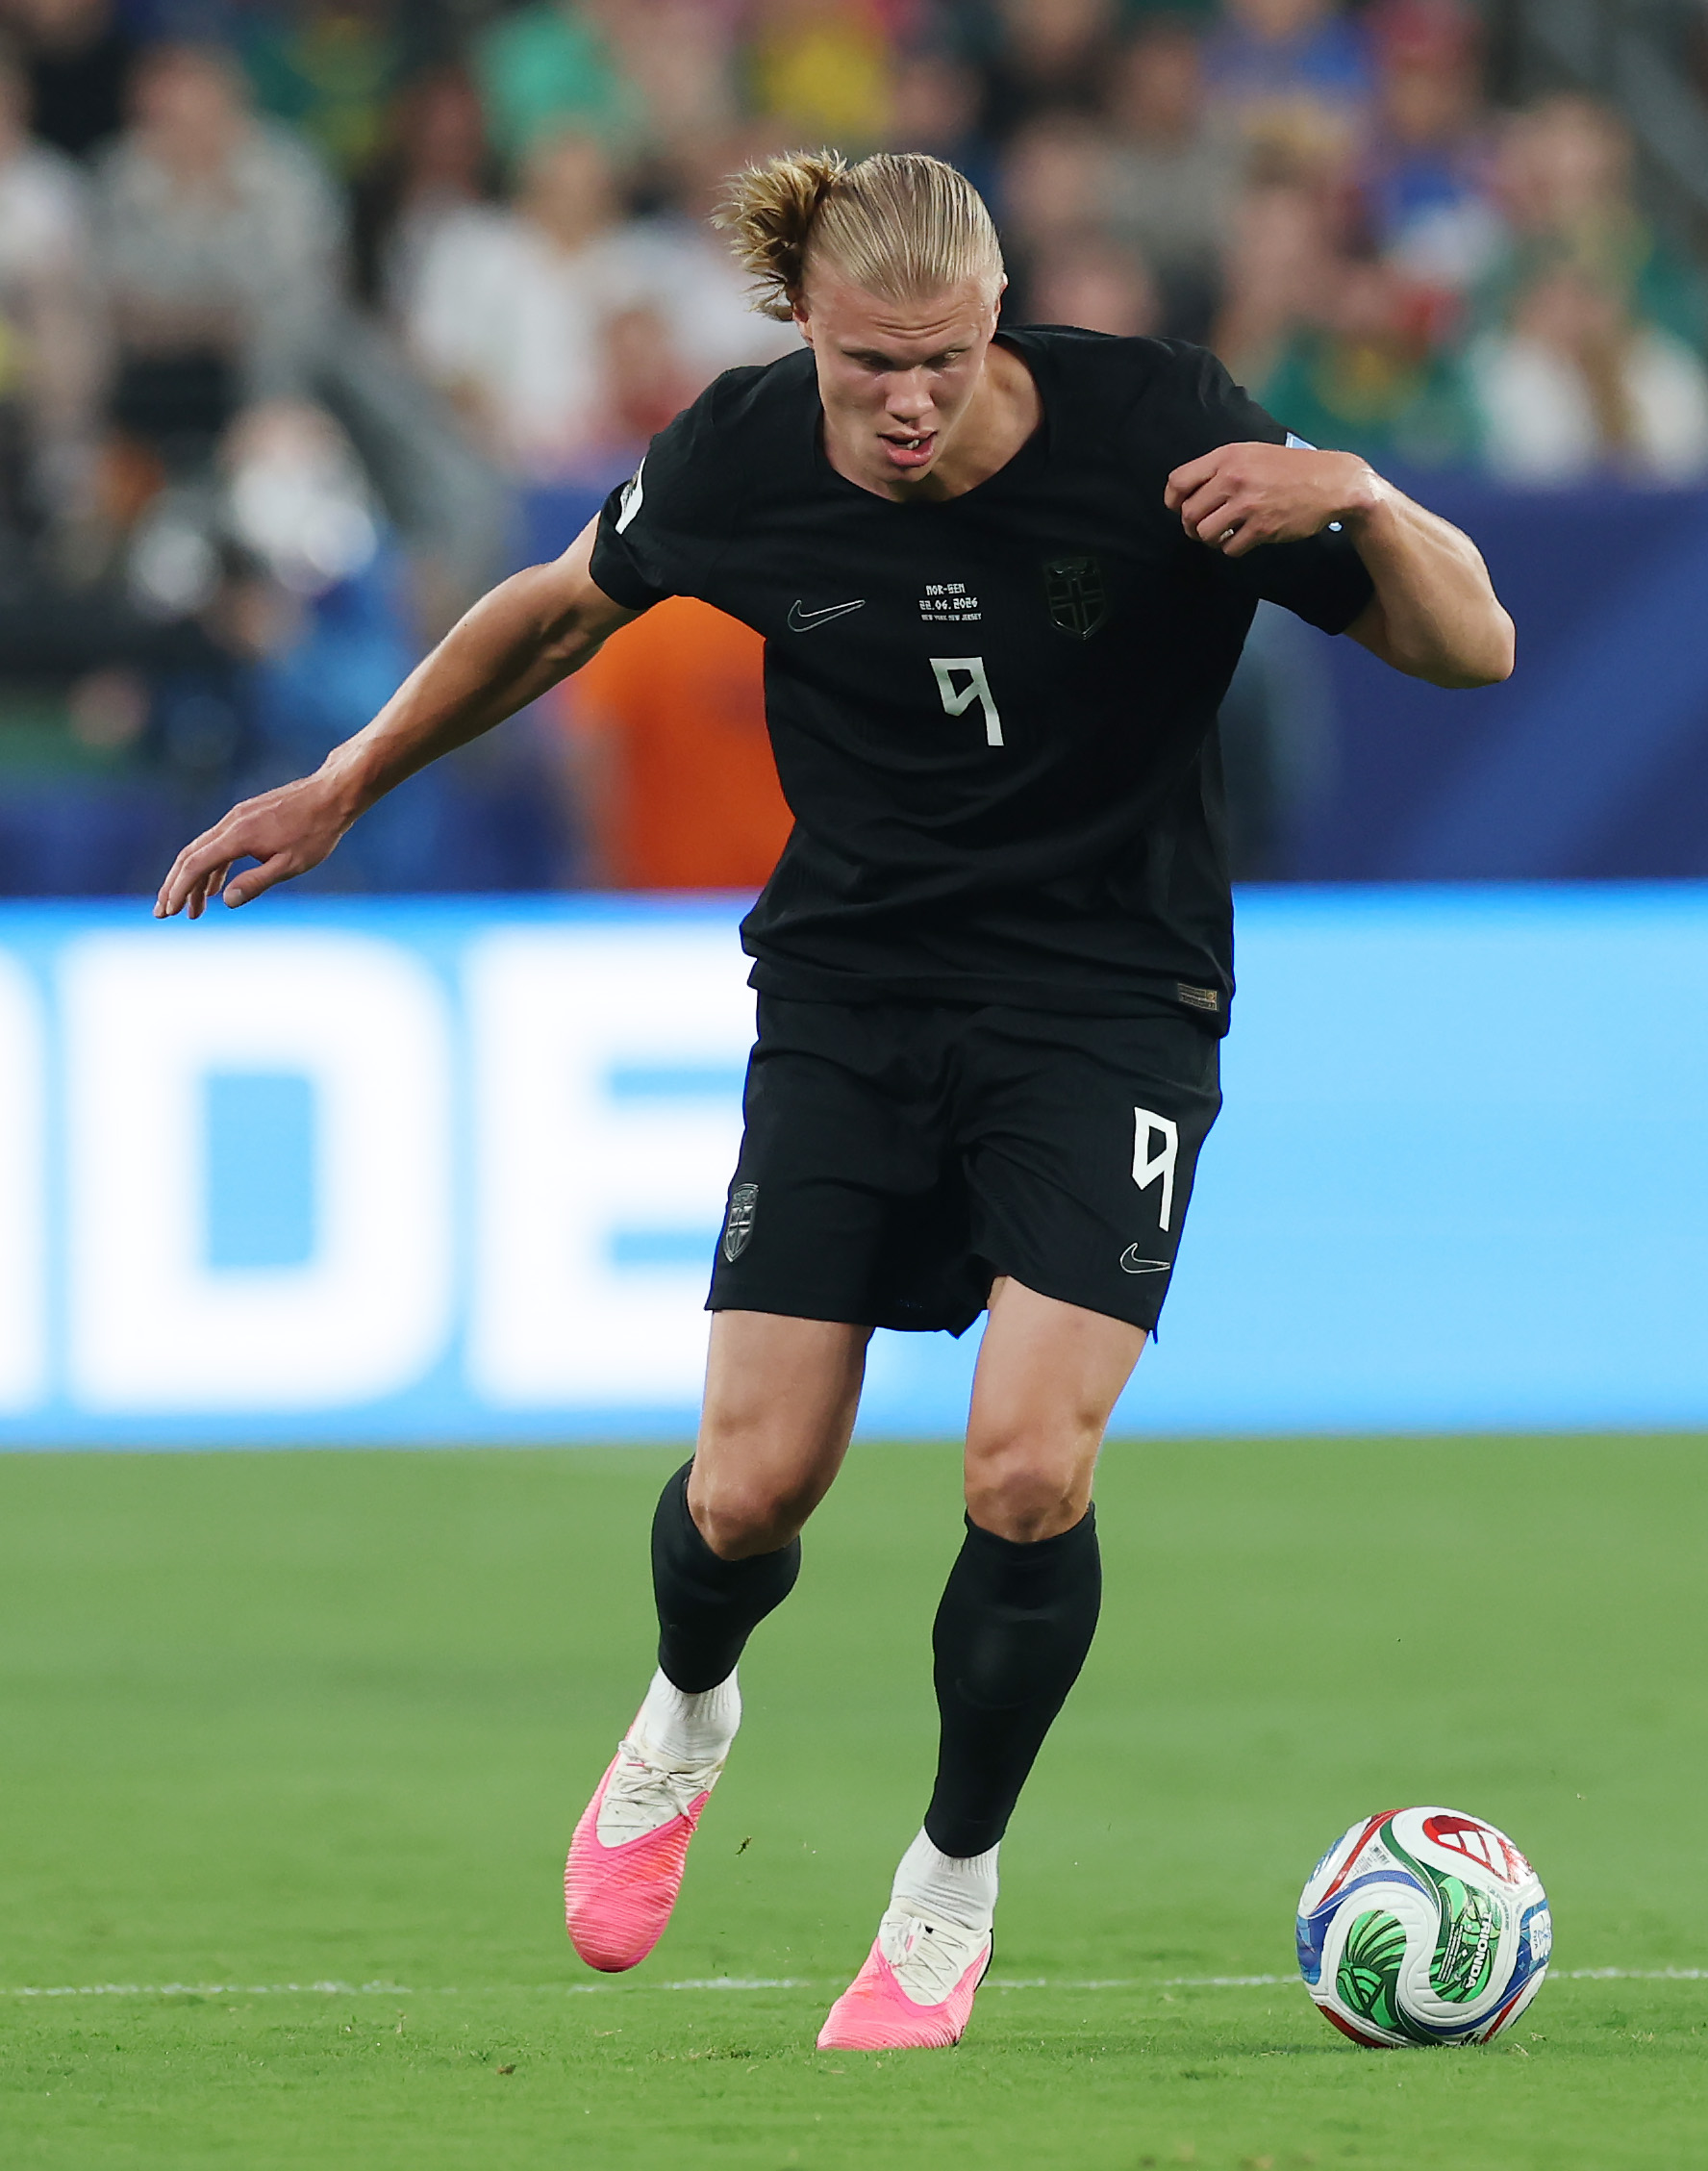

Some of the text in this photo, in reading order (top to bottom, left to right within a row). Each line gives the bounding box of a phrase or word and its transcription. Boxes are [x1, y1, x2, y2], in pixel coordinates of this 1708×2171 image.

[918, 597, 978, 611] 22.06.2026
[925, 583, 966, 595] NOR-SEN
[929, 656, 1004, 746] 9
[0, 929, 762, 1414] DE
[1132, 1106, 1178, 1232] 9
[1465, 1911, 1493, 1989] TRIONDA
